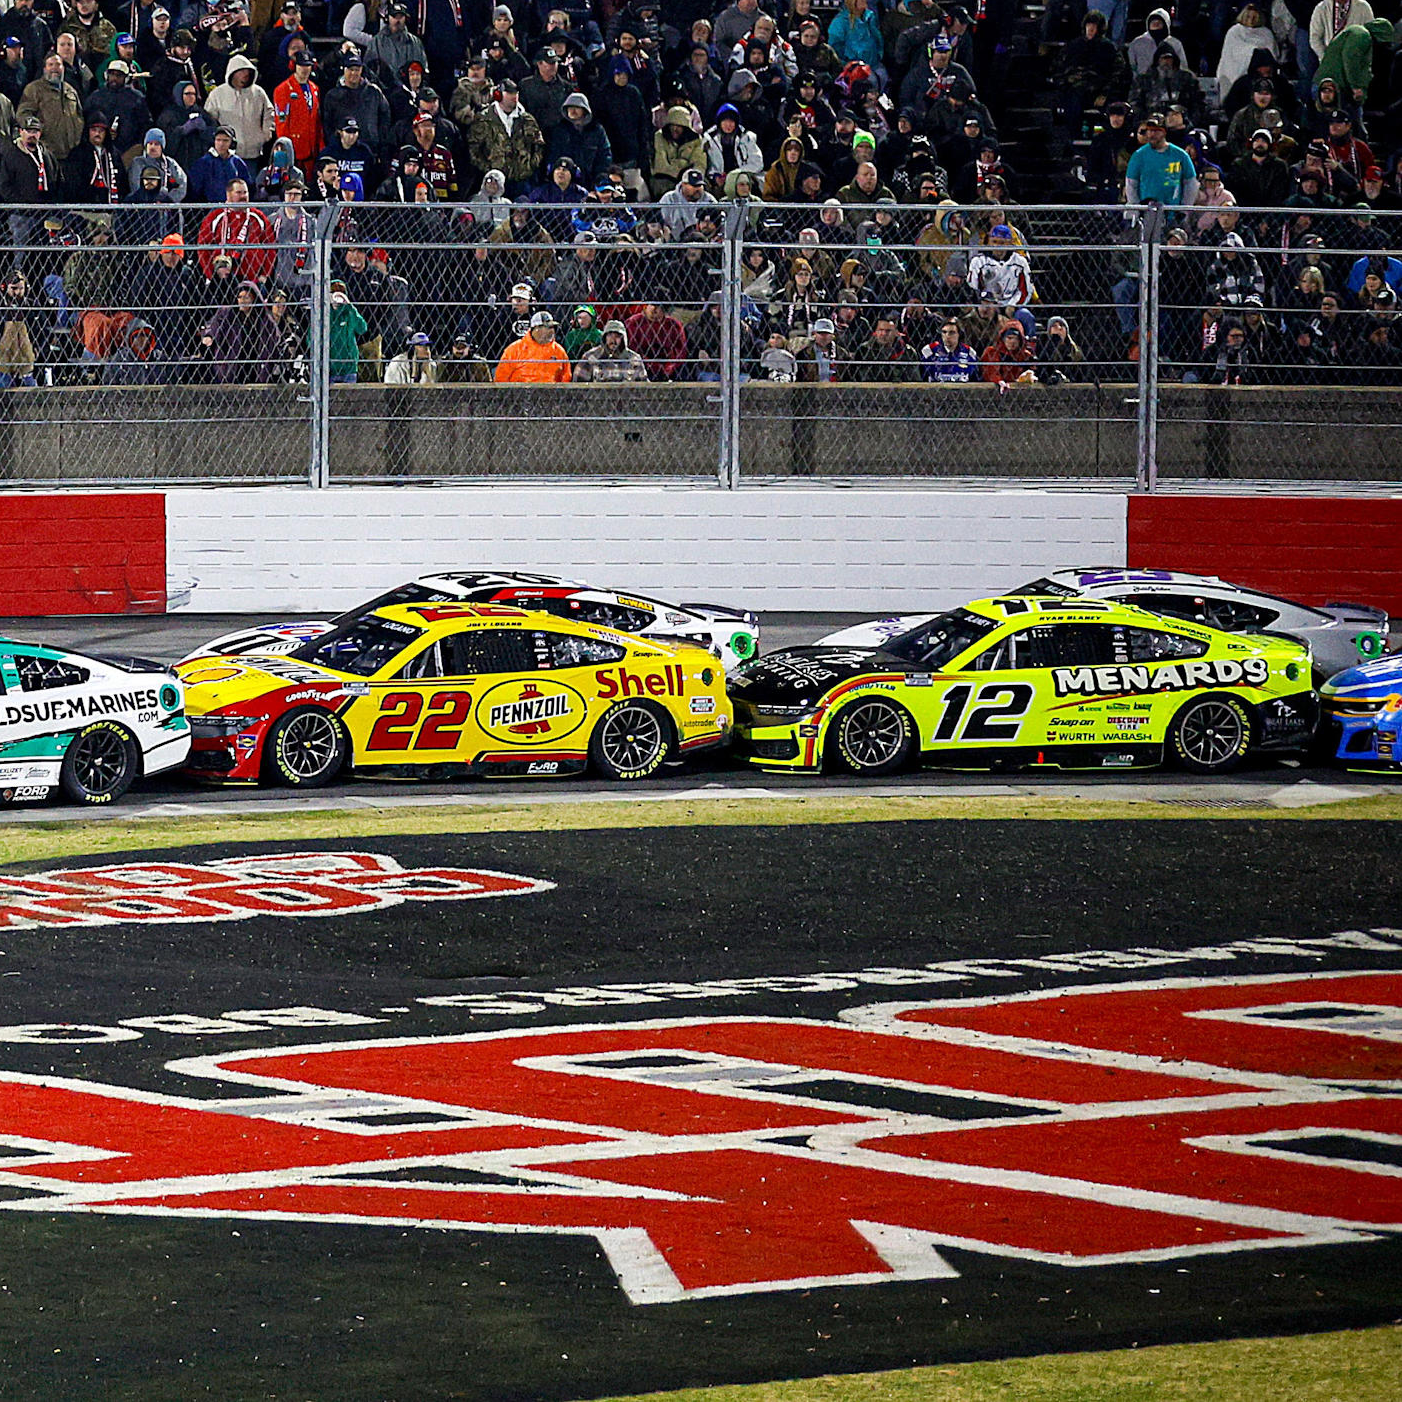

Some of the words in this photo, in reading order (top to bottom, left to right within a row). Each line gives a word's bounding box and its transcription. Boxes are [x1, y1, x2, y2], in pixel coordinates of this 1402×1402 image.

[596, 665, 683, 698] Shell
[1054, 659, 1268, 696] MENARDS
[366, 691, 472, 751] 22
[490, 695, 572, 727] PENNZOIL
[932, 683, 1034, 743] 12
[1048, 717, 1095, 728] Snap-on
[1102, 733, 1153, 741] WABASH
[14, 785, 50, 796] FORD
